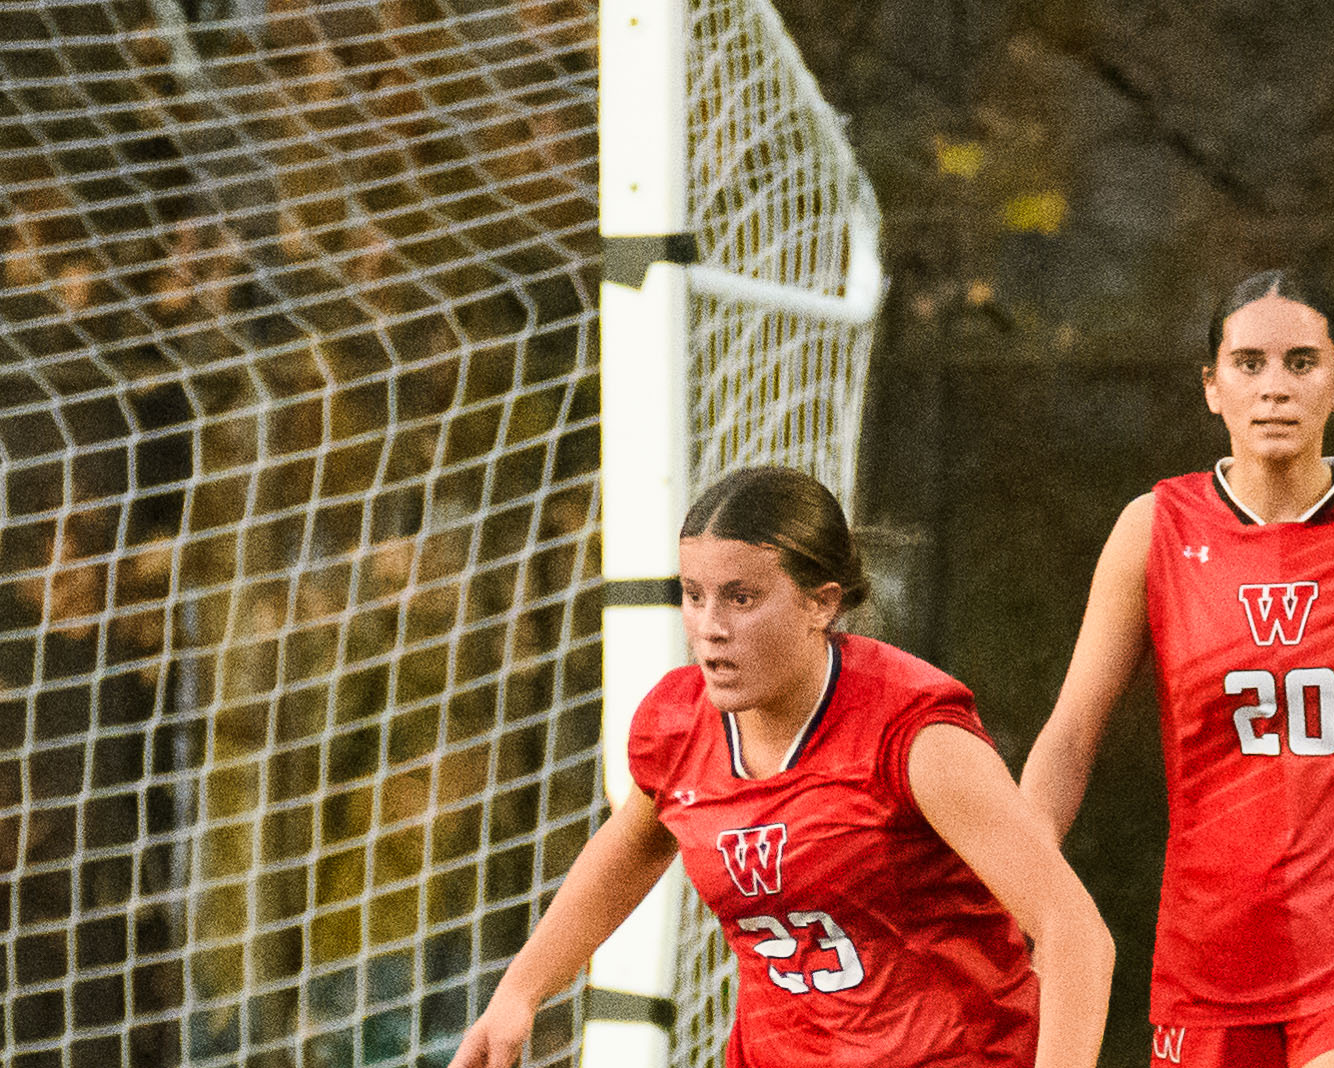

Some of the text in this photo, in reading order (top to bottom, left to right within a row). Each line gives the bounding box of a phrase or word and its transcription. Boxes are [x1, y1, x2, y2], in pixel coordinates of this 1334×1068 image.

[1239, 581, 1318, 646] W
[717, 823, 787, 896] W
[738, 911, 866, 994] 23
